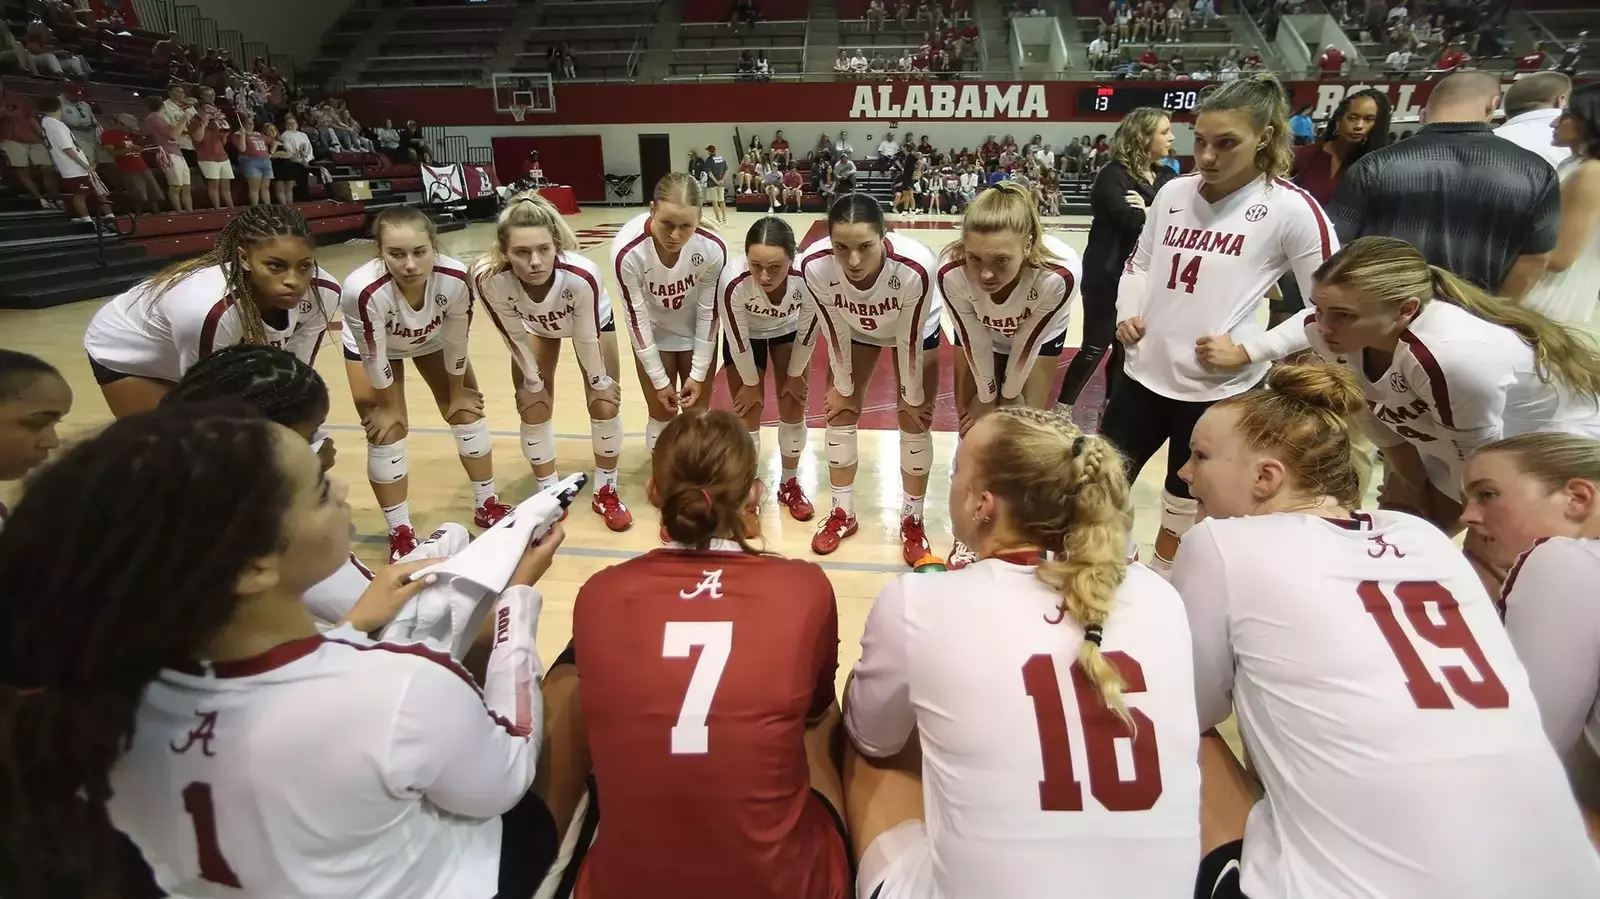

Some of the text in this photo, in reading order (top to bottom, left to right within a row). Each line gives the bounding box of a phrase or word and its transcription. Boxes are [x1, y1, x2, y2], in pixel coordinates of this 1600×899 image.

[849, 85, 1048, 118] ALABAMA
[1095, 97, 1108, 110] 13
[1163, 92, 1197, 109] 1:30
[1245, 204, 1268, 222] SEC
[1162, 225, 1245, 256] ALABAMA
[649, 273, 698, 296] LABAM
[1166, 253, 1202, 294] 14
[860, 318, 877, 330] 9
[680, 569, 724, 598] A
[494, 606, 510, 649] ROLL
[1356, 580, 1509, 709] 19
[662, 621, 733, 753] 7
[170, 710, 218, 757] A
[1021, 650, 1163, 812] 16
[182, 781, 242, 889] 1
